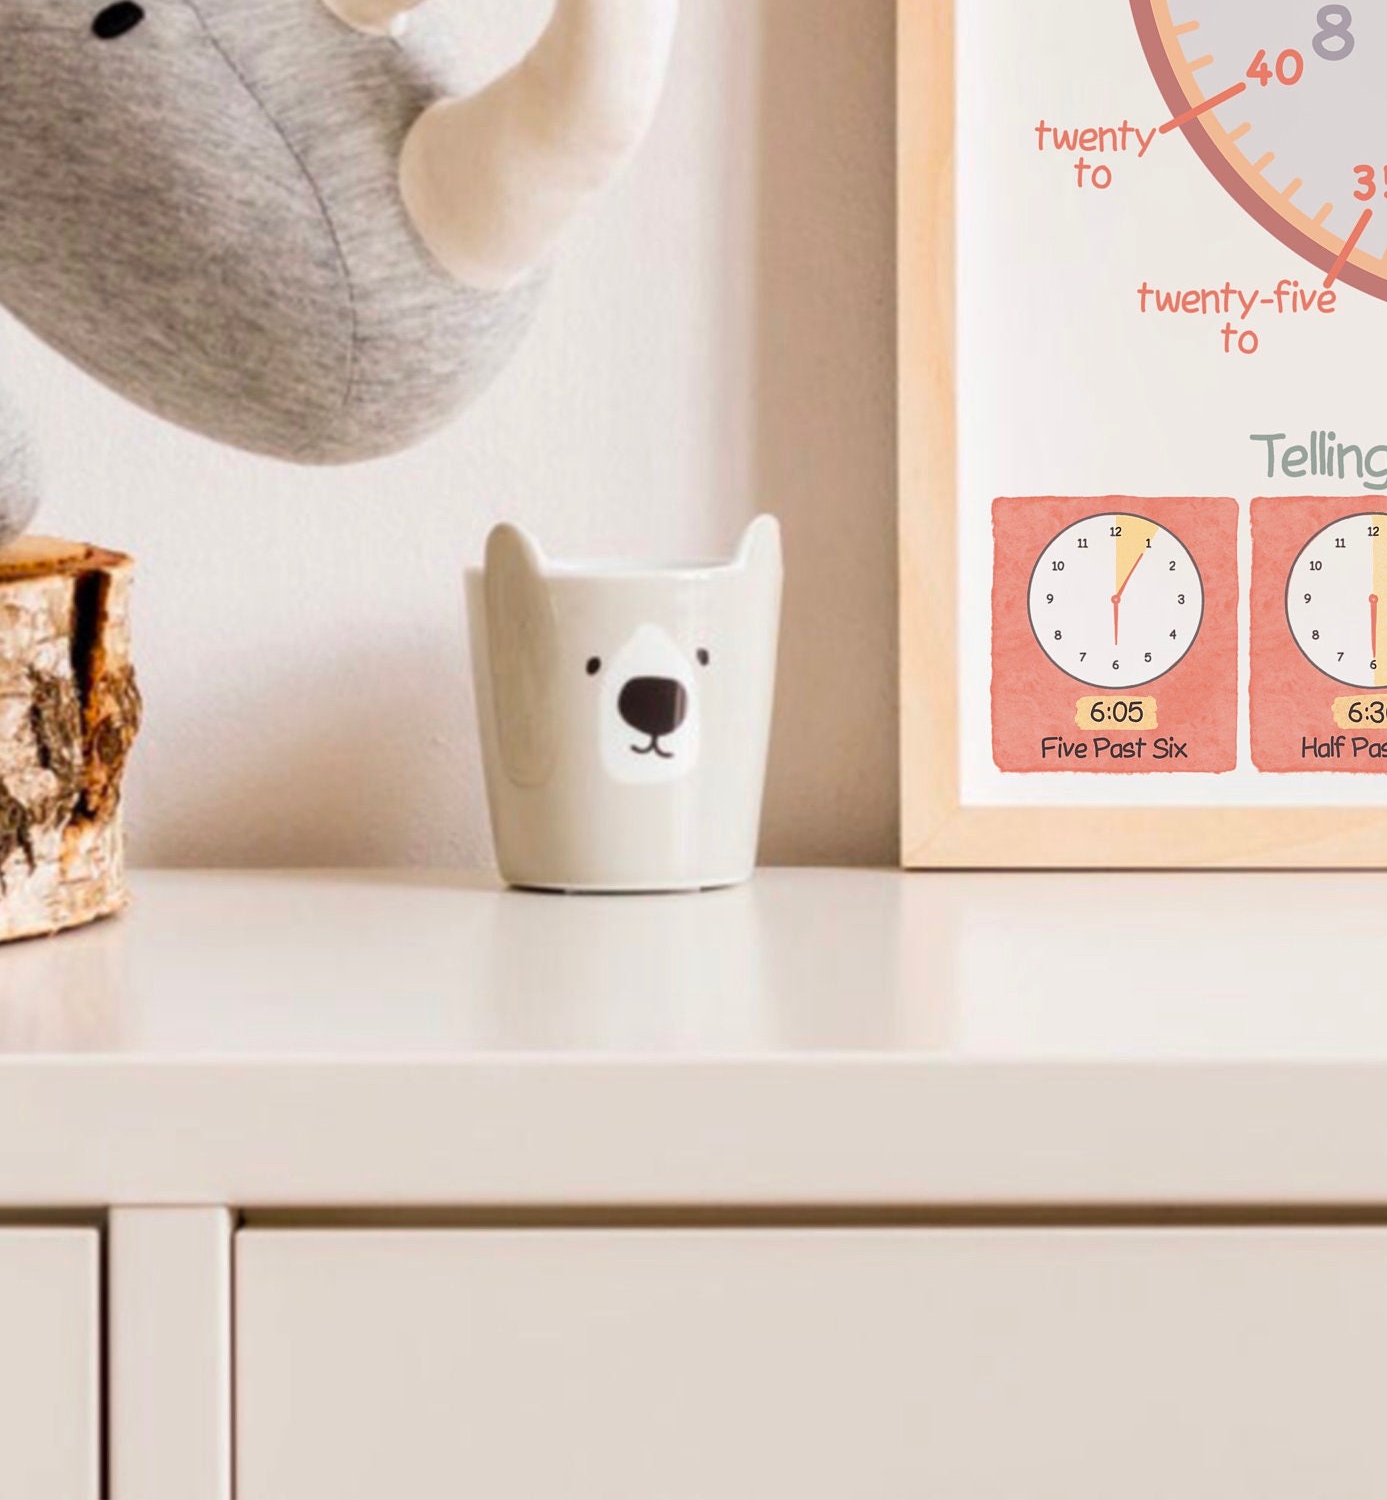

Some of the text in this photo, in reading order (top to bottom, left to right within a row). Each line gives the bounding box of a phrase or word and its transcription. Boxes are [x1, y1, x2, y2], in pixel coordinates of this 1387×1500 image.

[1312, 4, 1354, 61] 8
[1246, 49, 1303, 86] 40
[1035, 120, 1157, 158] twenty
[1074, 157, 1111, 189] to
[1137, 279, 1336, 319] twenty-five
[1221, 322, 1258, 354] to
[1110, 527, 1121, 536] 12
[1368, 526, 1379, 536] 12
[1078, 538, 1088, 548] 11
[1146, 538, 1151, 548] 1
[1335, 538, 1346, 548] 11
[1052, 561, 1064, 571] 10
[1169, 561, 1175, 571] 2
[1310, 561, 1322, 570] 10
[1047, 594, 1054, 604] 9
[1178, 594, 1185, 604] 3
[1304, 593, 1311, 603] 9
[1054, 630, 1062, 640] 8
[1169, 629, 1176, 640] 4
[1312, 630, 1319, 640] 8
[1080, 652, 1086, 662] 7
[1144, 652, 1151, 662] 5
[1337, 652, 1344, 661] 7
[1112, 660, 1119, 669] 6
[1370, 660, 1377, 669] 6
[1091, 701, 1143, 722] 6:05
[1042, 737, 1187, 759] Five Past Six
[1302, 736, 1346, 758] Half
